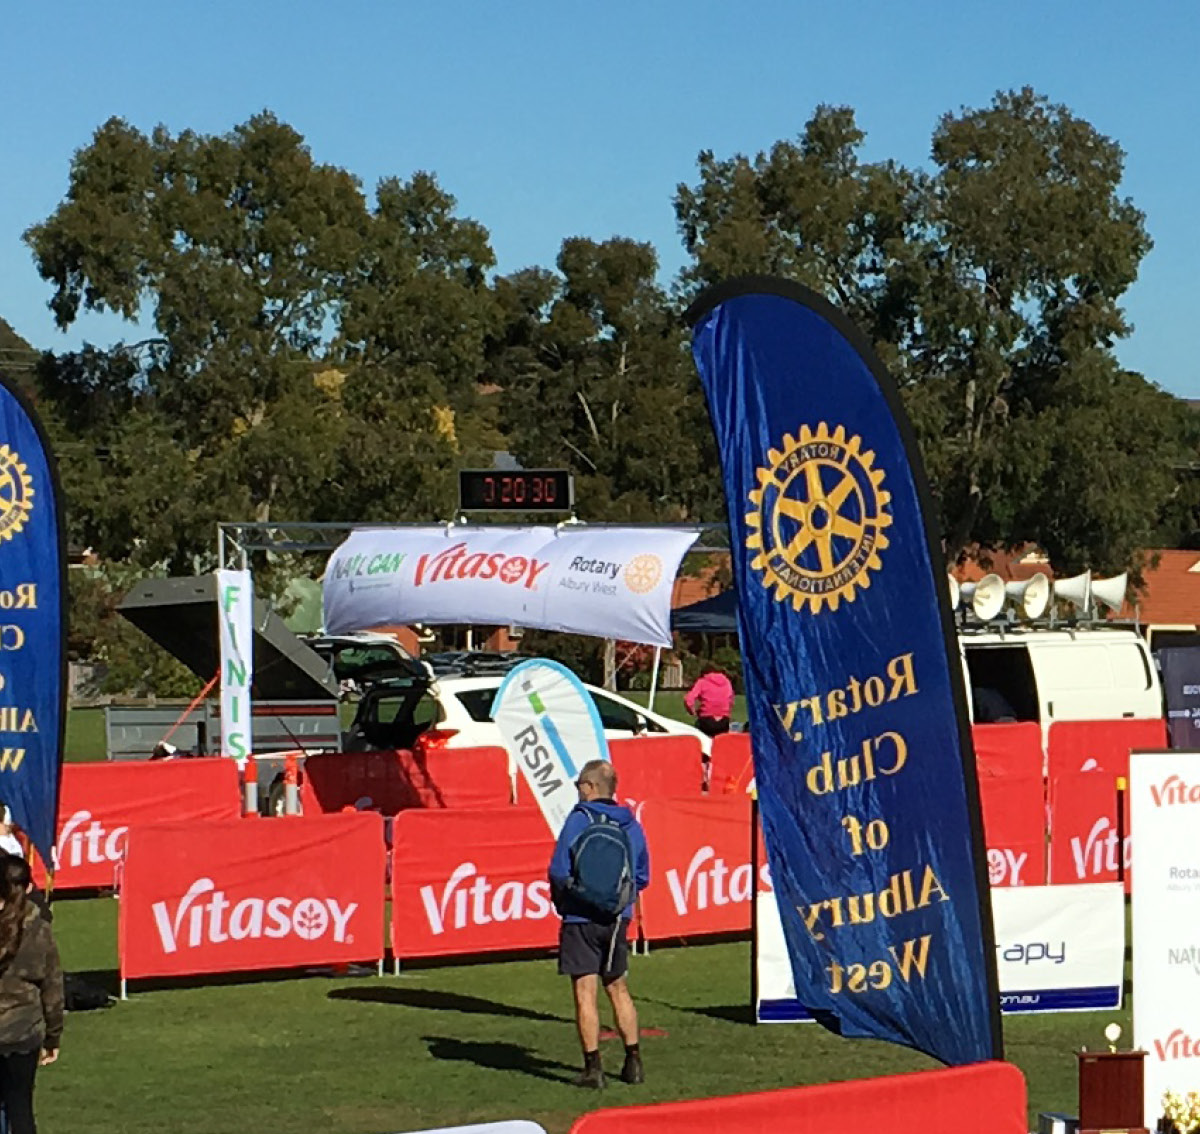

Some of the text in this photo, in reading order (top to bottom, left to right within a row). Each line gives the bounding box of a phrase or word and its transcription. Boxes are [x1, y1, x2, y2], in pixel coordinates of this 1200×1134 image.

[568, 556, 622, 579] Rotary
[224, 586, 247, 759] FINIS
[514, 725, 563, 797] RSM
[1002, 942, 1066, 965] apy
